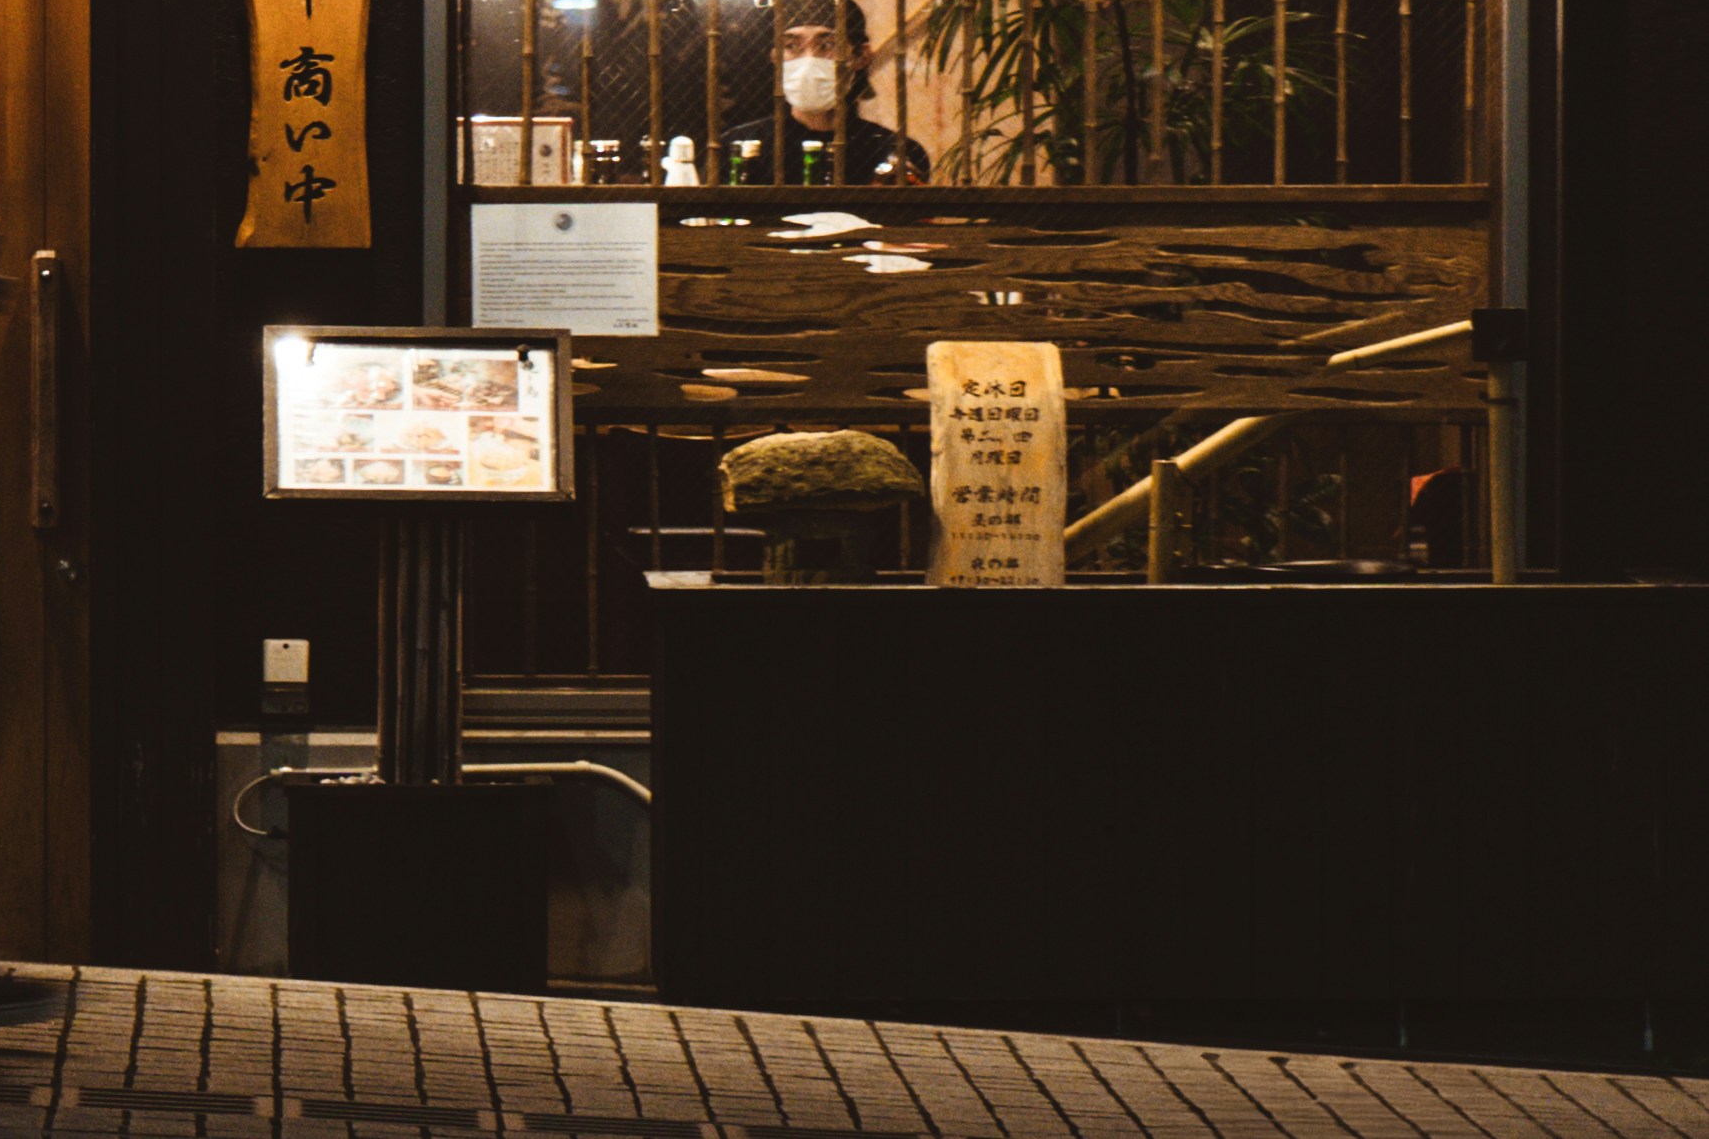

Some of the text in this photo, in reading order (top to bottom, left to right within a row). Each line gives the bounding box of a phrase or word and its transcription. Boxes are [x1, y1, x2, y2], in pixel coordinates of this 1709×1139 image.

[278, 45, 338, 225] 商い中
[961, 379, 1028, 399] 定休日
[950, 484, 1041, 506] 営業時間
